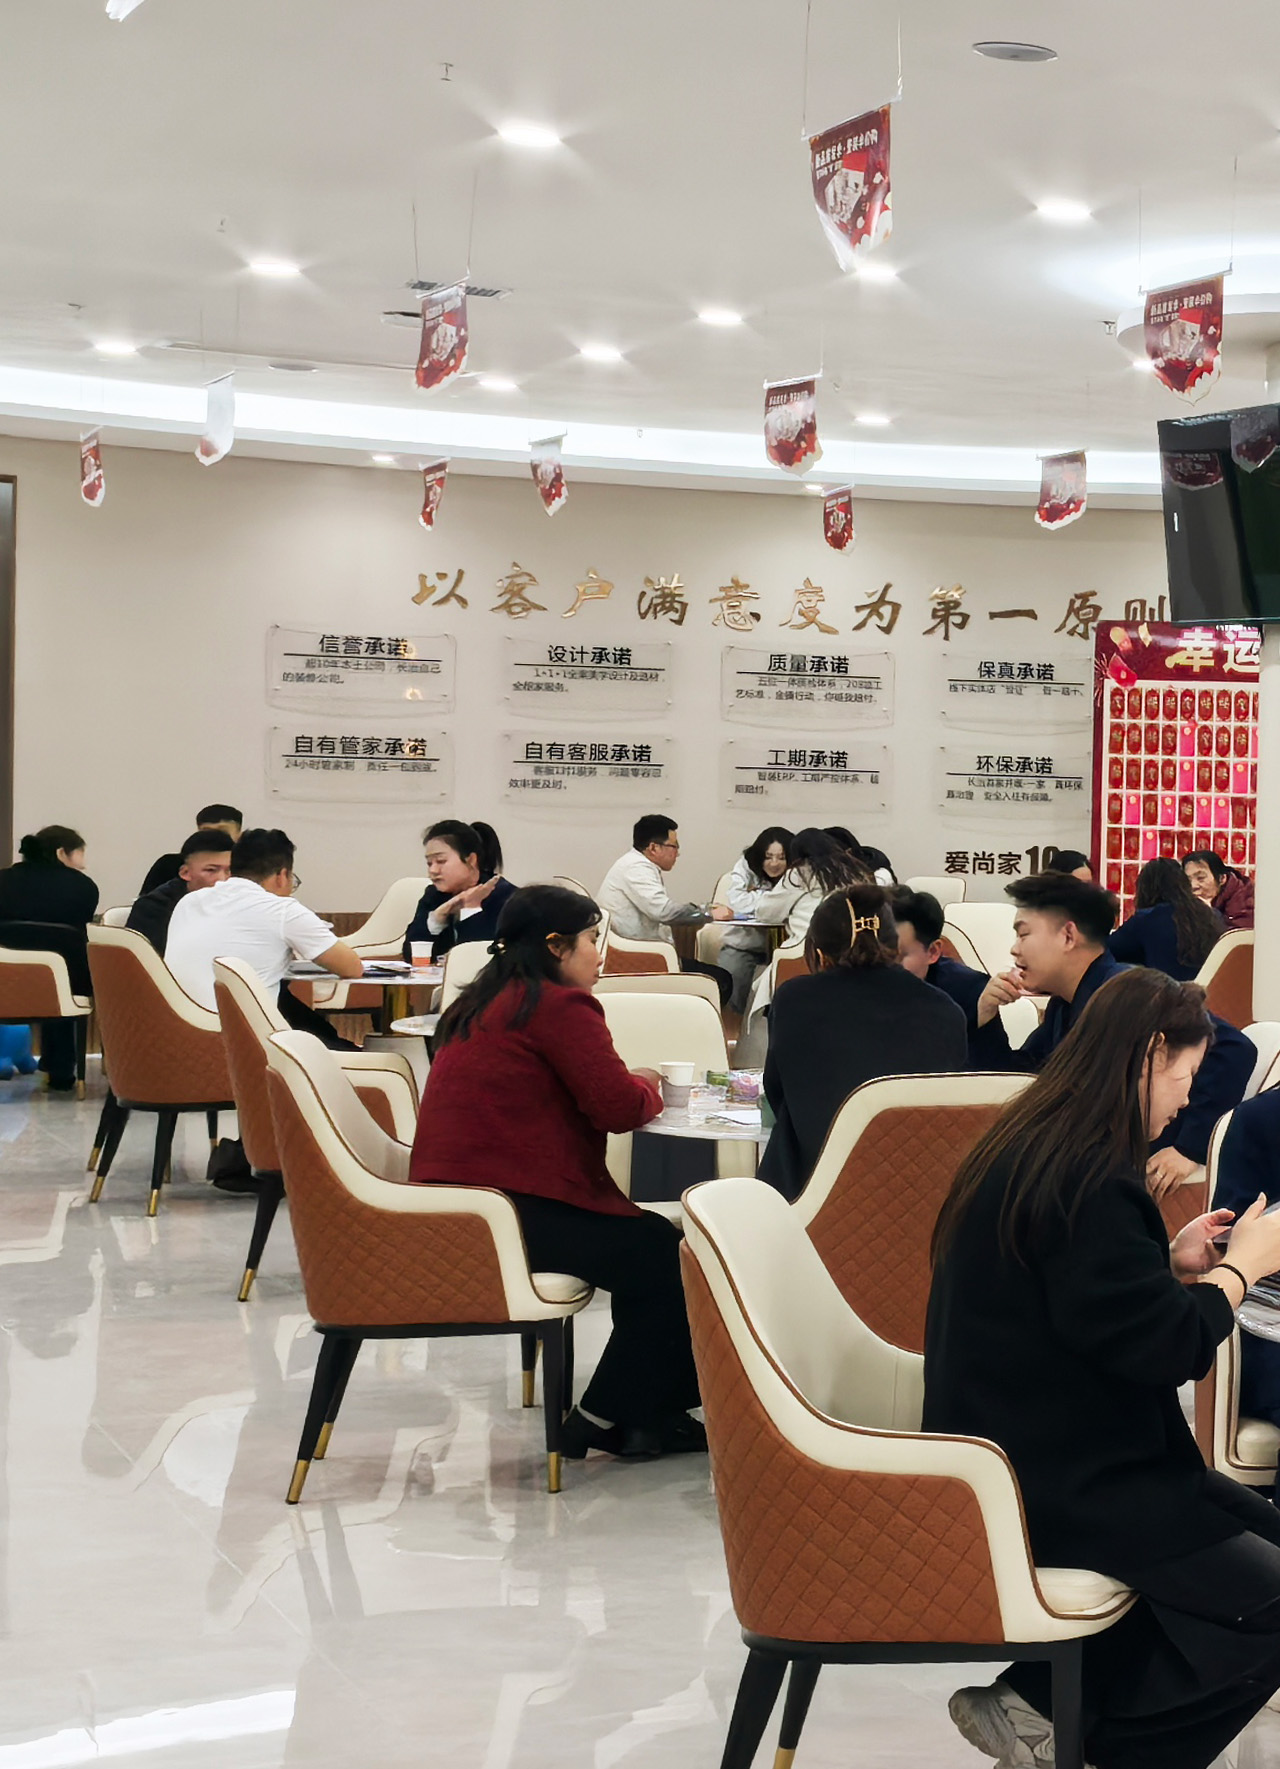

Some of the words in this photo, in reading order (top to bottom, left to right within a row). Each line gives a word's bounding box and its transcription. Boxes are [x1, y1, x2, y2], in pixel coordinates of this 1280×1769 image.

[410, 561, 1167, 641] 以客户满意度为第一原则
[318, 634, 408, 658] 信誉承诺
[547, 644, 632, 666] 设计承诺
[1172, 627, 1260, 673] 幸运
[767, 653, 850, 674] 质量承诺
[977, 661, 1055, 681] 保真承诺
[294, 734, 428, 757] 自有管家承诺
[525, 741, 652, 763] 自有客服承诺
[766, 749, 849, 769] 工期承诺
[975, 755, 1053, 774] 环保承诺
